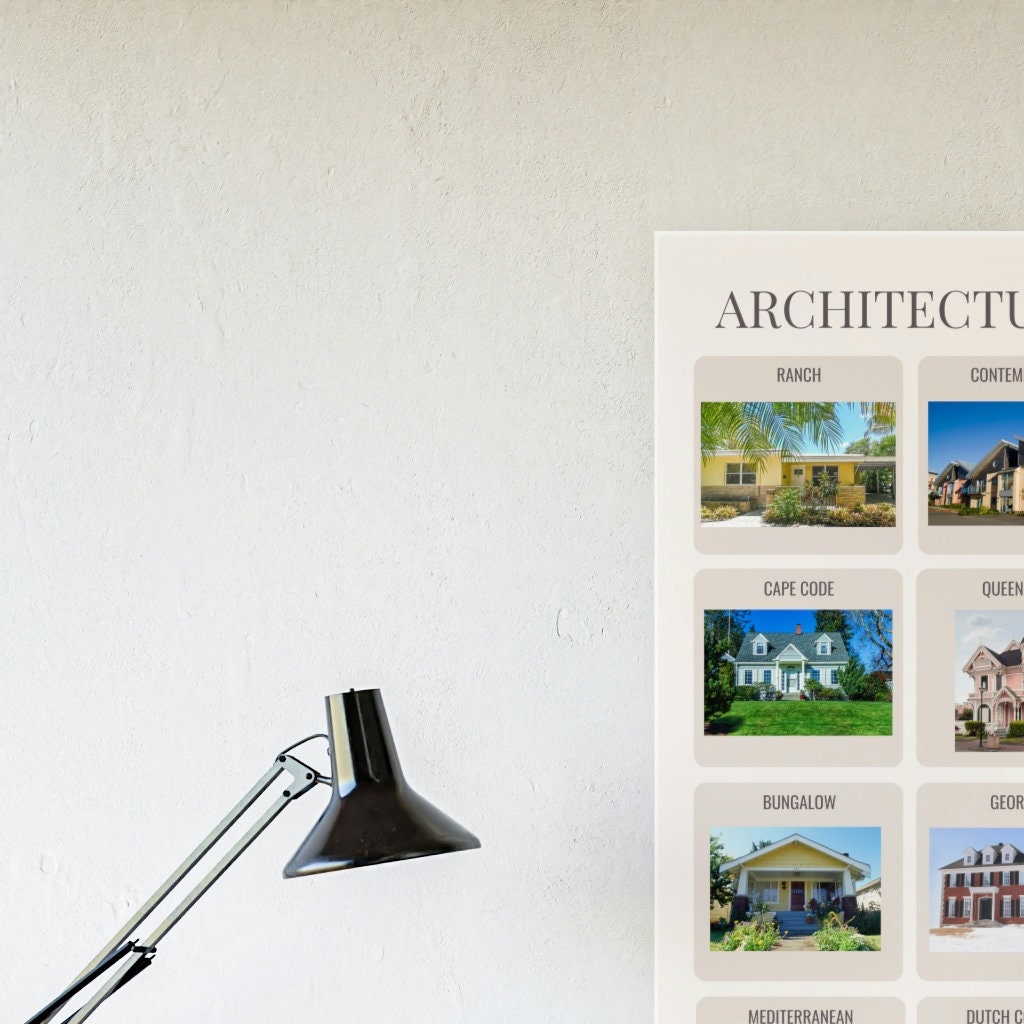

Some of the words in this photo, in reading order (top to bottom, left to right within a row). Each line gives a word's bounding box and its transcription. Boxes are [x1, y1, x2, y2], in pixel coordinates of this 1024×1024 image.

[776, 367, 822, 383] RANCH
[763, 580, 797, 597] CAPE
[800, 580, 835, 597] CODE
[982, 580, 1024, 598] QUEEN
[763, 794, 837, 811] BUNGALOW
[748, 1009, 854, 1024] MEDITERRANEAN
[966, 1009, 1010, 1024] DUTCH
